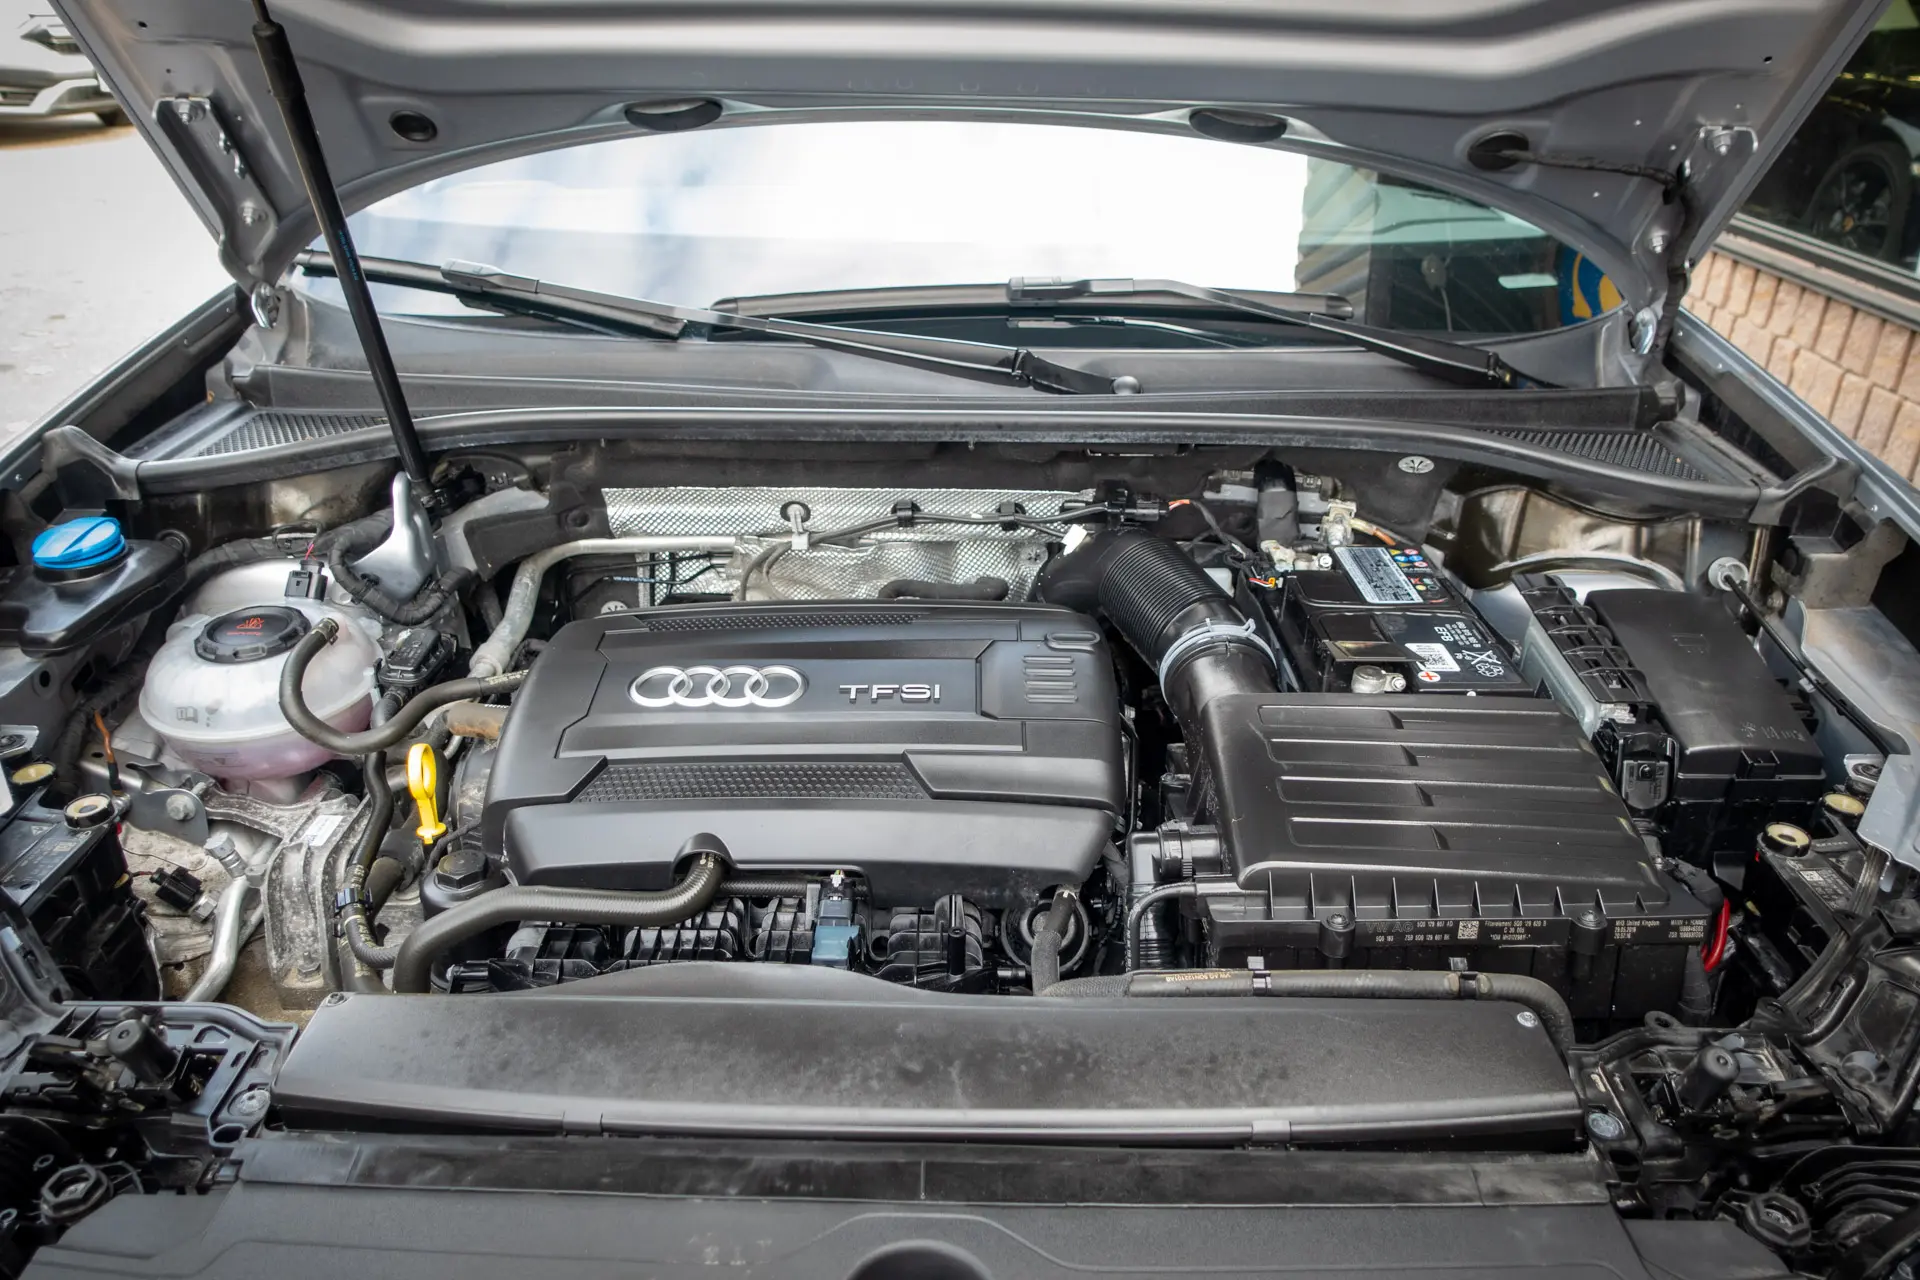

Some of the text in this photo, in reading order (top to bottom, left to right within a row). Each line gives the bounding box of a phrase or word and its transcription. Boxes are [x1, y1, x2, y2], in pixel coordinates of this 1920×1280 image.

[1434, 626, 1453, 642] EFB
[839, 684, 941, 703] TFSI
[1366, 921, 1414, 933] VW AG
